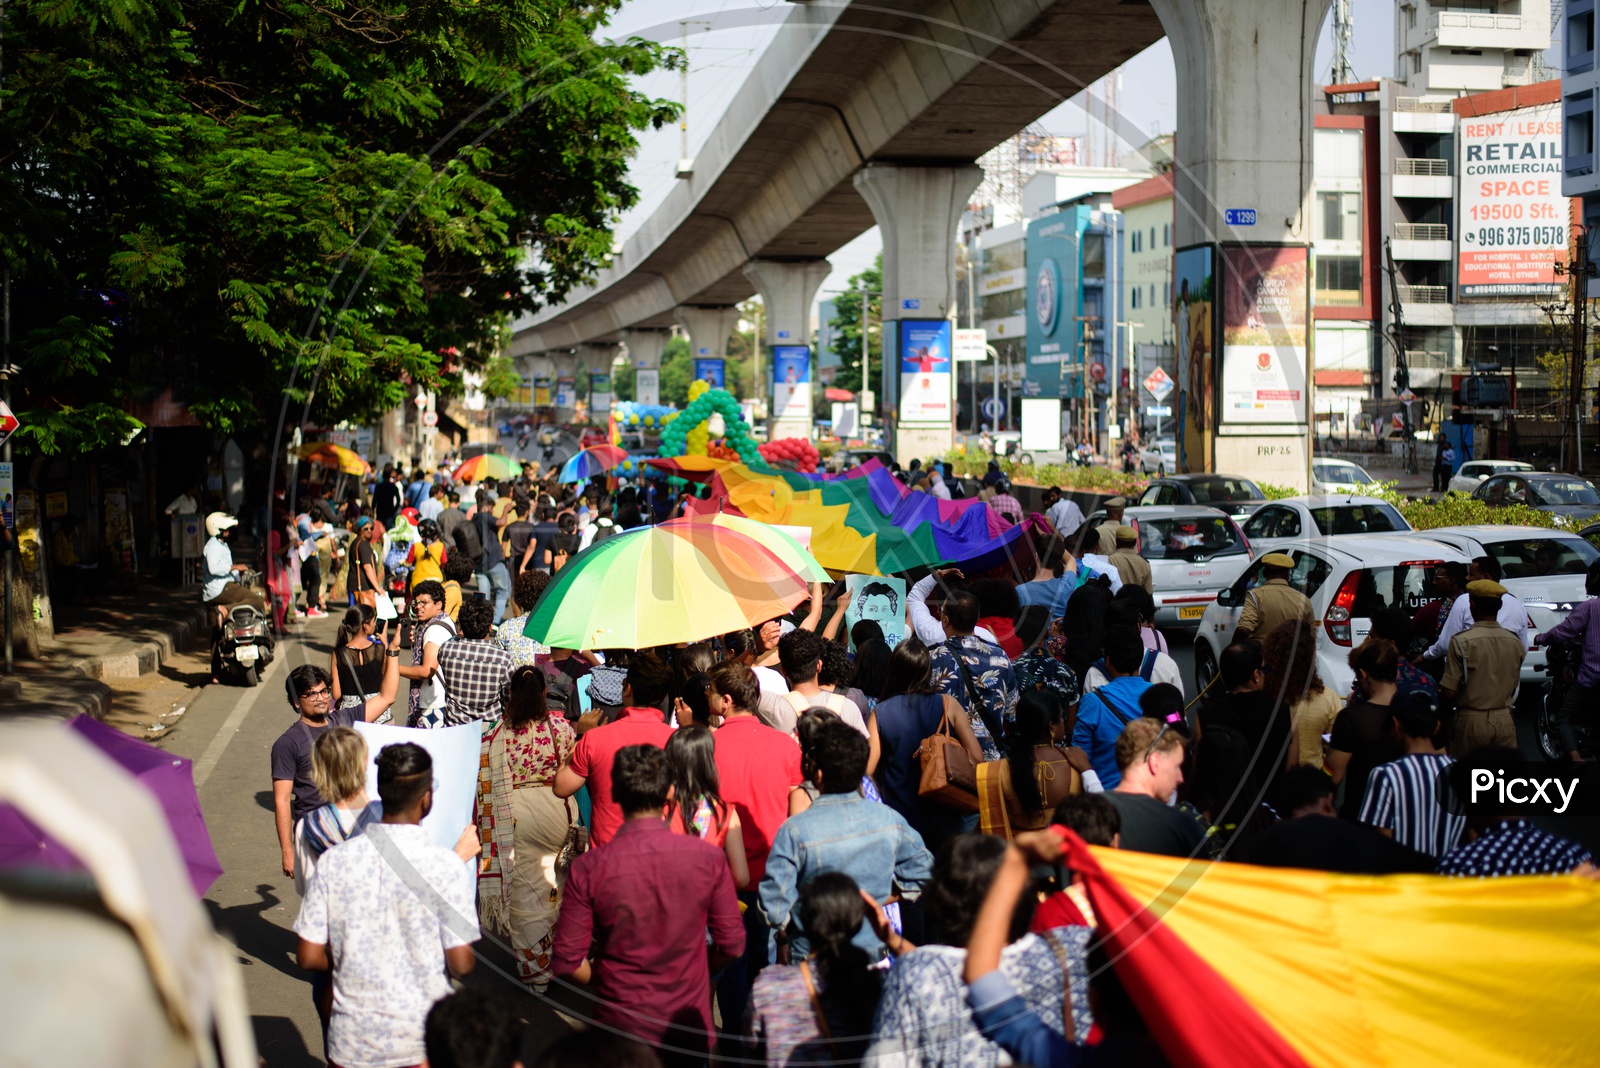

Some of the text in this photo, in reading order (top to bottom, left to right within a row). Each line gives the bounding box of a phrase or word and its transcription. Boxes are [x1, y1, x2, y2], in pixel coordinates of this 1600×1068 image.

[1466, 122, 1505, 138] RENT
[1518, 121, 1562, 136] LEASE
[1466, 142, 1562, 162] RETAIL
[1466, 163, 1562, 175] COMMERCIAL
[1480, 180, 1550, 197] SPACE
[1226, 211, 1255, 223] C 1299
[1470, 203, 1559, 221] 19500 Sft.
[1479, 226, 1564, 246] 996 375 0578
[1489, 253, 1522, 261] HOSPITAL
[1464, 262, 1511, 271] EDUCATIONAL
[1410, 597, 1442, 608] UBE
